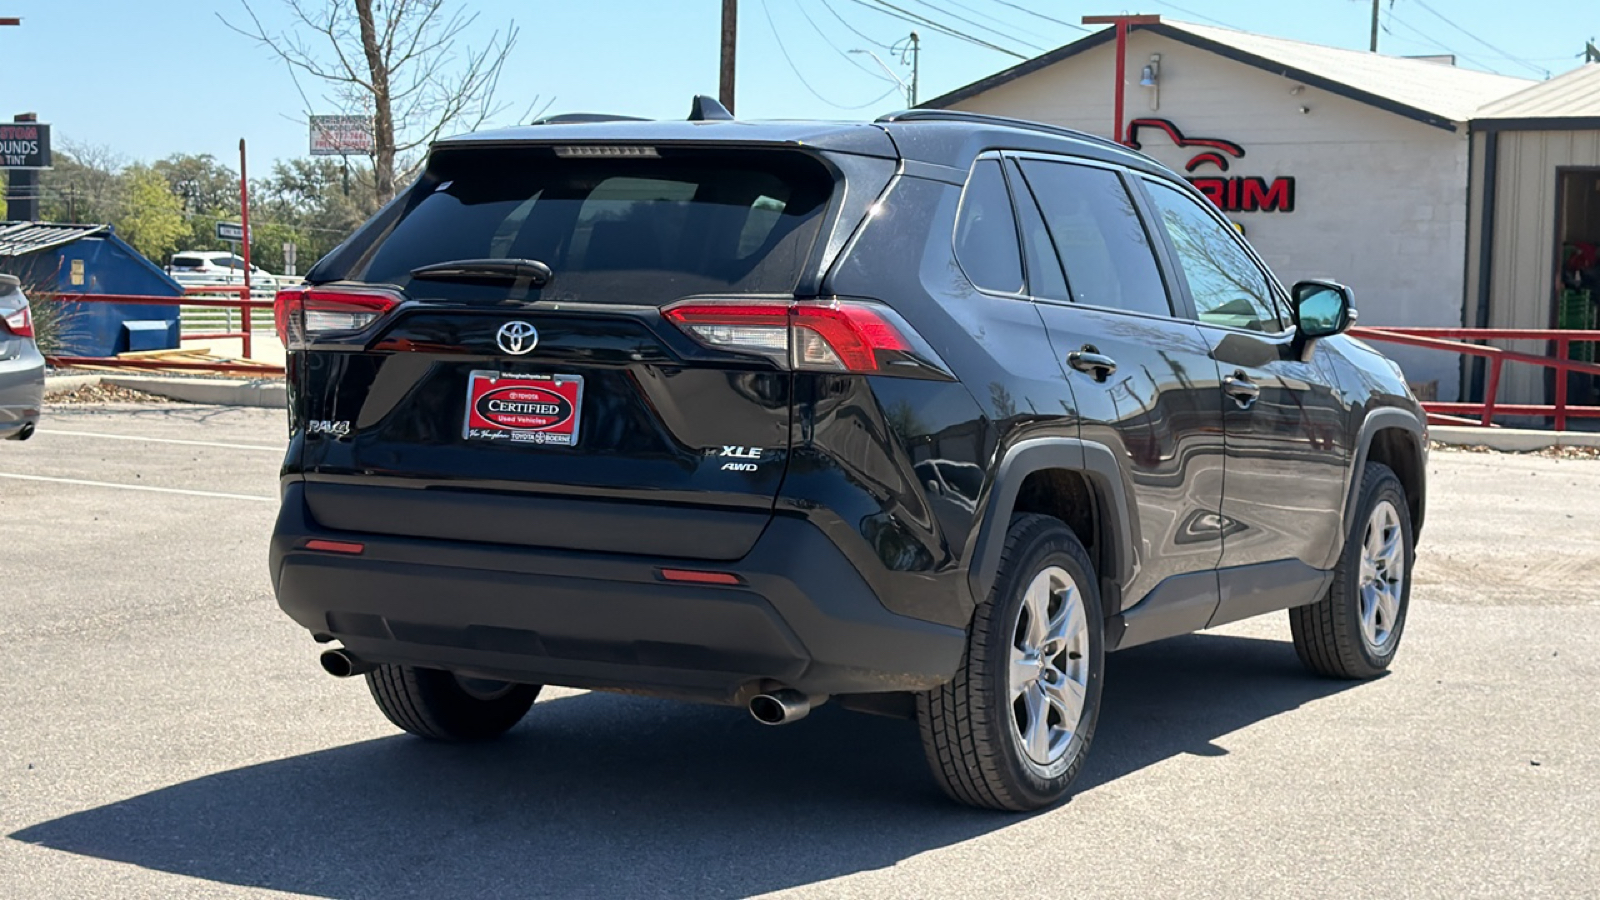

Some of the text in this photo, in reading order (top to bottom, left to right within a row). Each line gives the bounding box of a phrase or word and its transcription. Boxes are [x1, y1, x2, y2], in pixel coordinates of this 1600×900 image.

[5, 154, 27, 165] TINT
[517, 416, 547, 425] Vehicles
[720, 445, 763, 459] XLE
[721, 462, 758, 471] AWD
